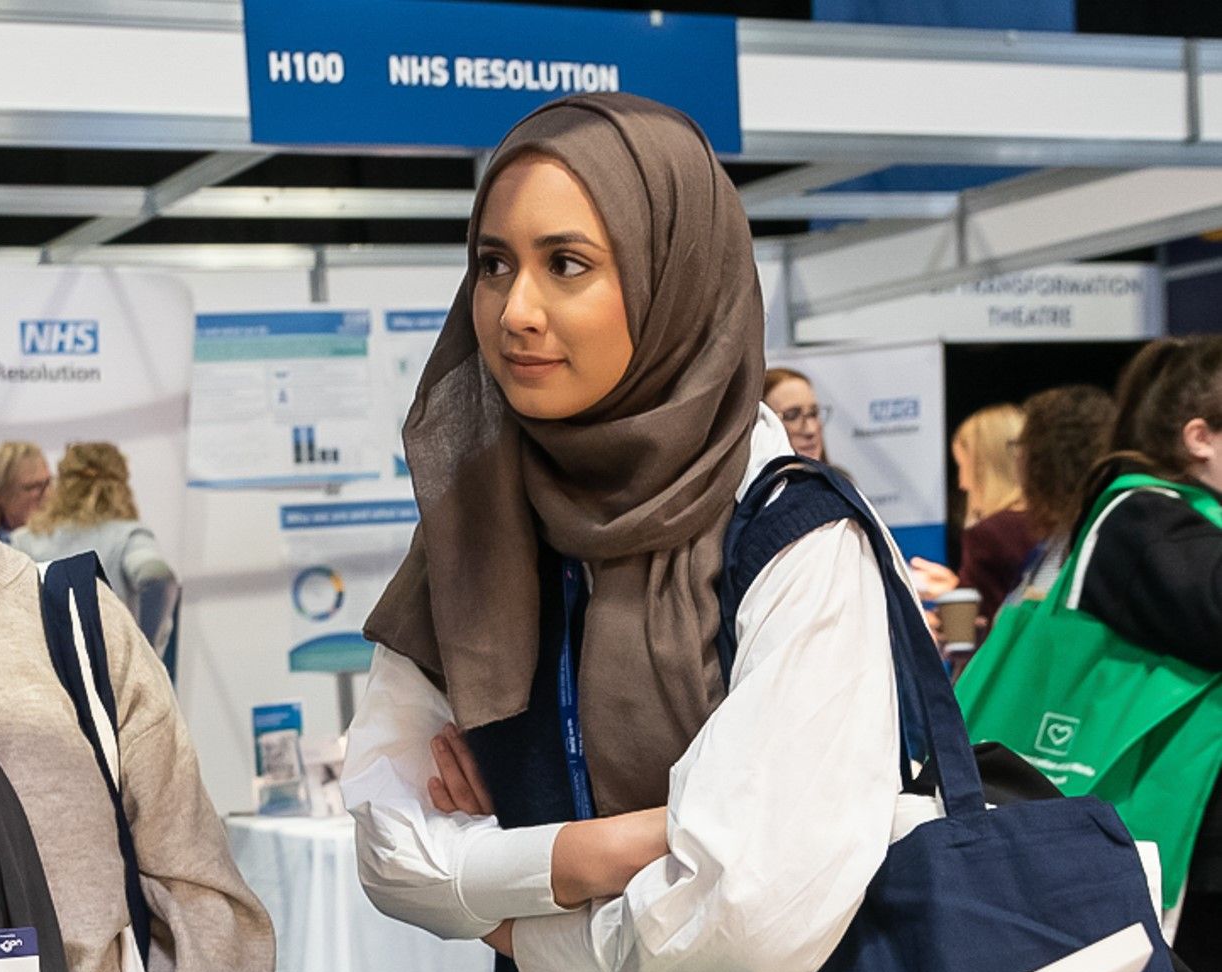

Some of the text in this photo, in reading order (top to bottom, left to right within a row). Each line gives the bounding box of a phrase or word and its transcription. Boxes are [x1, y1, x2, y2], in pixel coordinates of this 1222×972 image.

[269, 52, 619, 93] H100 NHS RESOLUTION
[988, 304, 1071, 328] THEATRE
[24, 321, 97, 354] NHS
